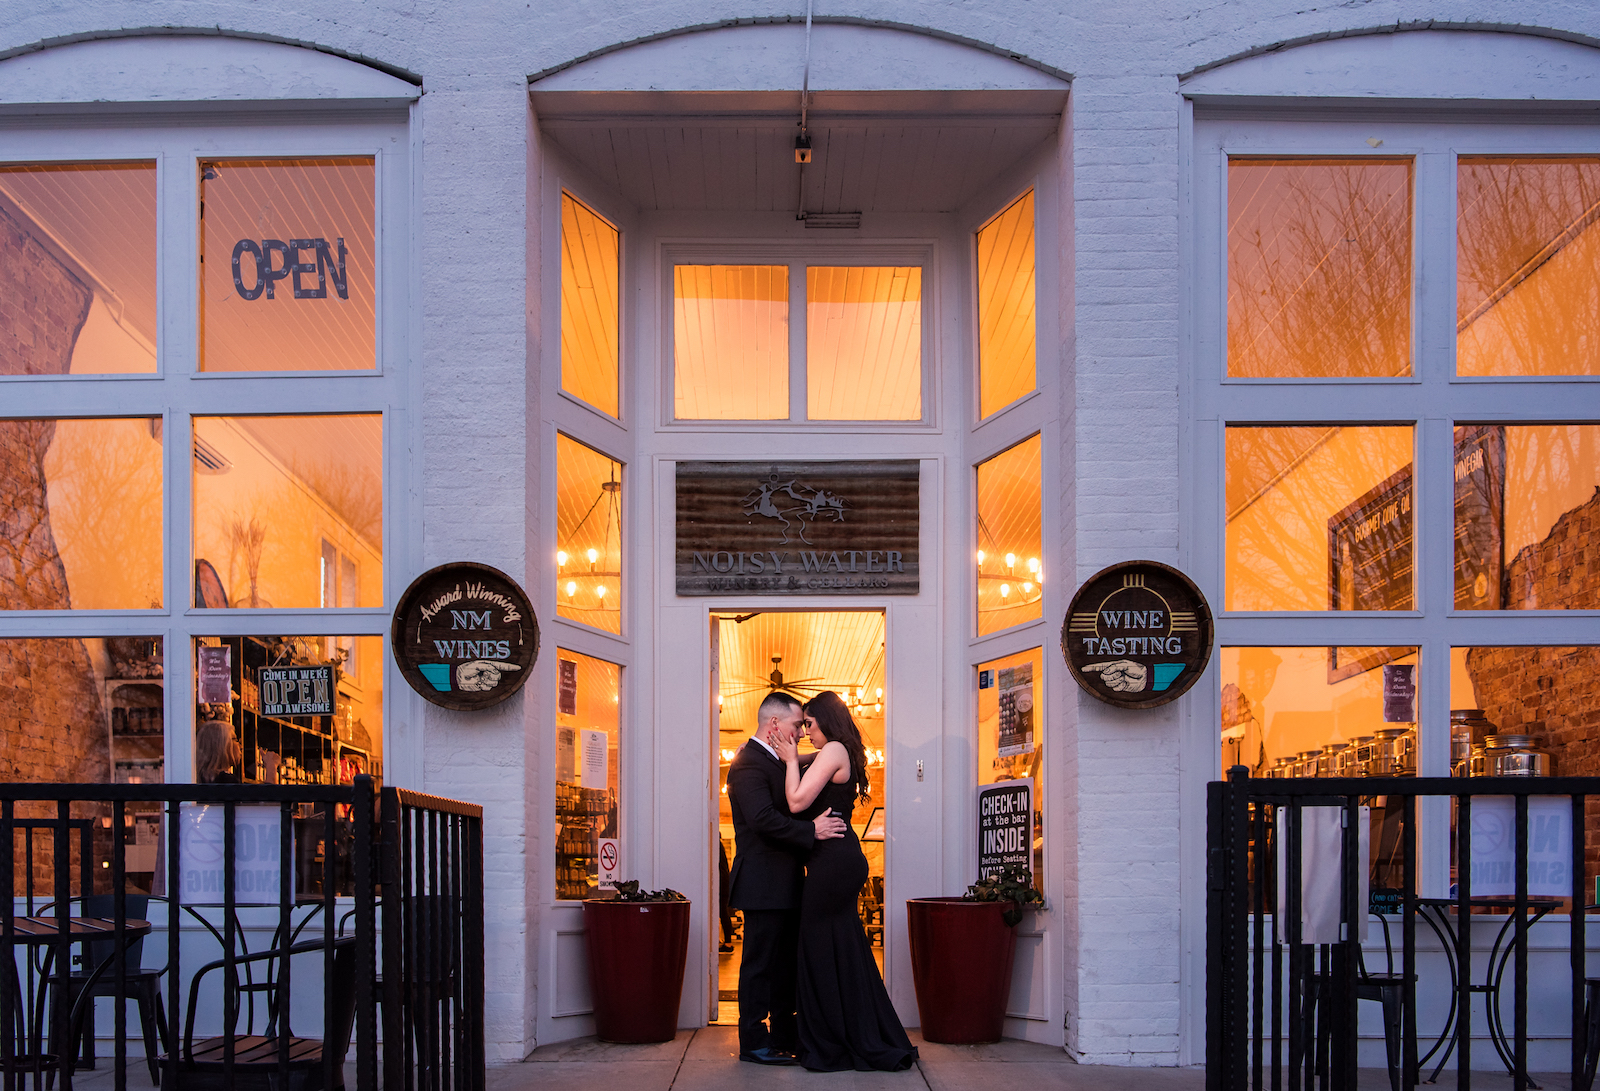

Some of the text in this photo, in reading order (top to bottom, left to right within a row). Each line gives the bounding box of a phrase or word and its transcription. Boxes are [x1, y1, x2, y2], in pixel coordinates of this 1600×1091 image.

[232, 238, 348, 300] OPEN
[1354, 512, 1381, 544] GOURMET
[1382, 501, 1399, 526] OLIVE
[692, 550, 904, 575] NOISY WATER
[707, 575, 889, 591] WINERY & CELLARS
[420, 581, 522, 623] Award Winning
[450, 610, 492, 630] NM
[1101, 610, 1164, 629] WINE
[433, 640, 511, 659] WINES
[1083, 637, 1182, 655] TASTING
[263, 671, 287, 681] COME
[289, 670, 298, 680] IN
[263, 679, 330, 705] OPEN
[265, 703, 330, 714] AND AWESOME
[981, 791, 1028, 816] CHECK-IN
[983, 813, 1026, 827] at the bar
[983, 826, 1025, 854] INSIDE
[981, 854, 1027, 865] Before Seating
